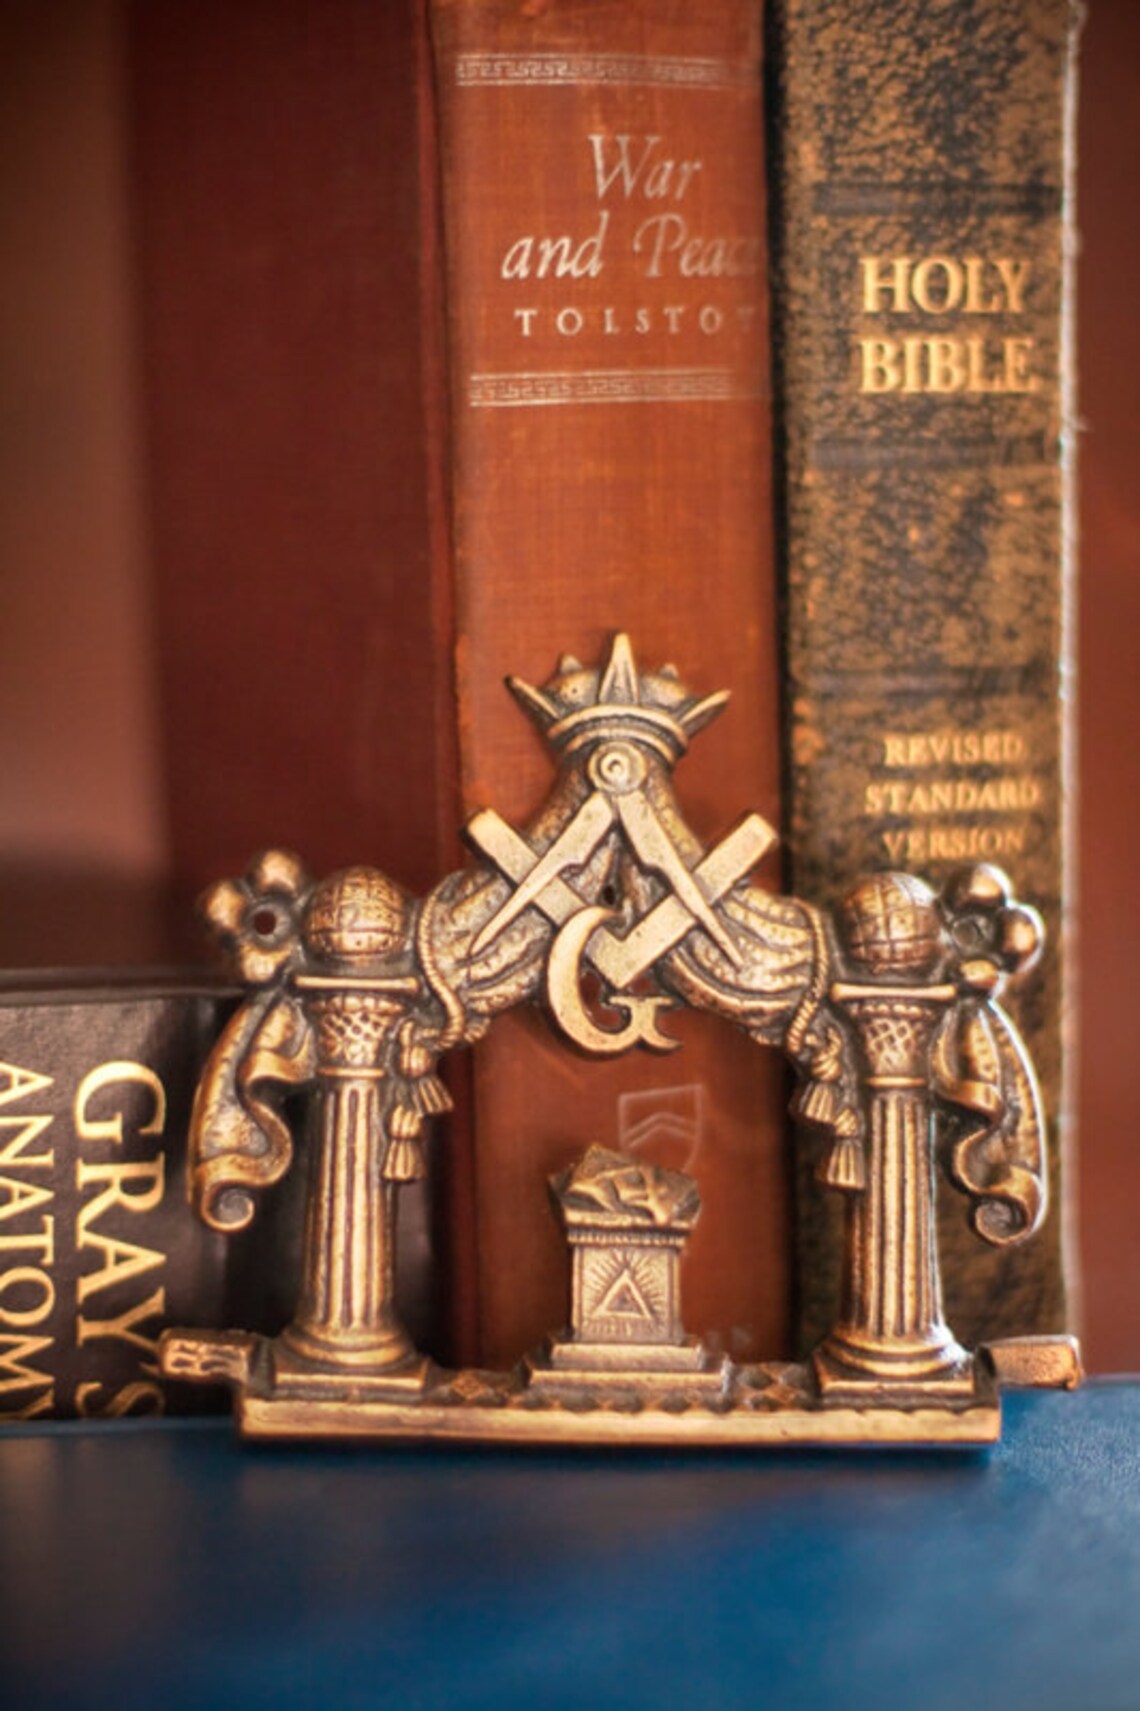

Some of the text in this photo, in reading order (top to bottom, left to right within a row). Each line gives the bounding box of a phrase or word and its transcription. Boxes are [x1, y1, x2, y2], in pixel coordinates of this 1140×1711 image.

[588, 133, 702, 200] War
[501, 209, 759, 280] and Peac
[859, 255, 1030, 314] HOLY
[858, 336, 1043, 394] BIBLE
[884, 731, 1026, 768] REVISED
[864, 777, 1041, 815] STANDARD
[882, 826, 1025, 863] VERSION
